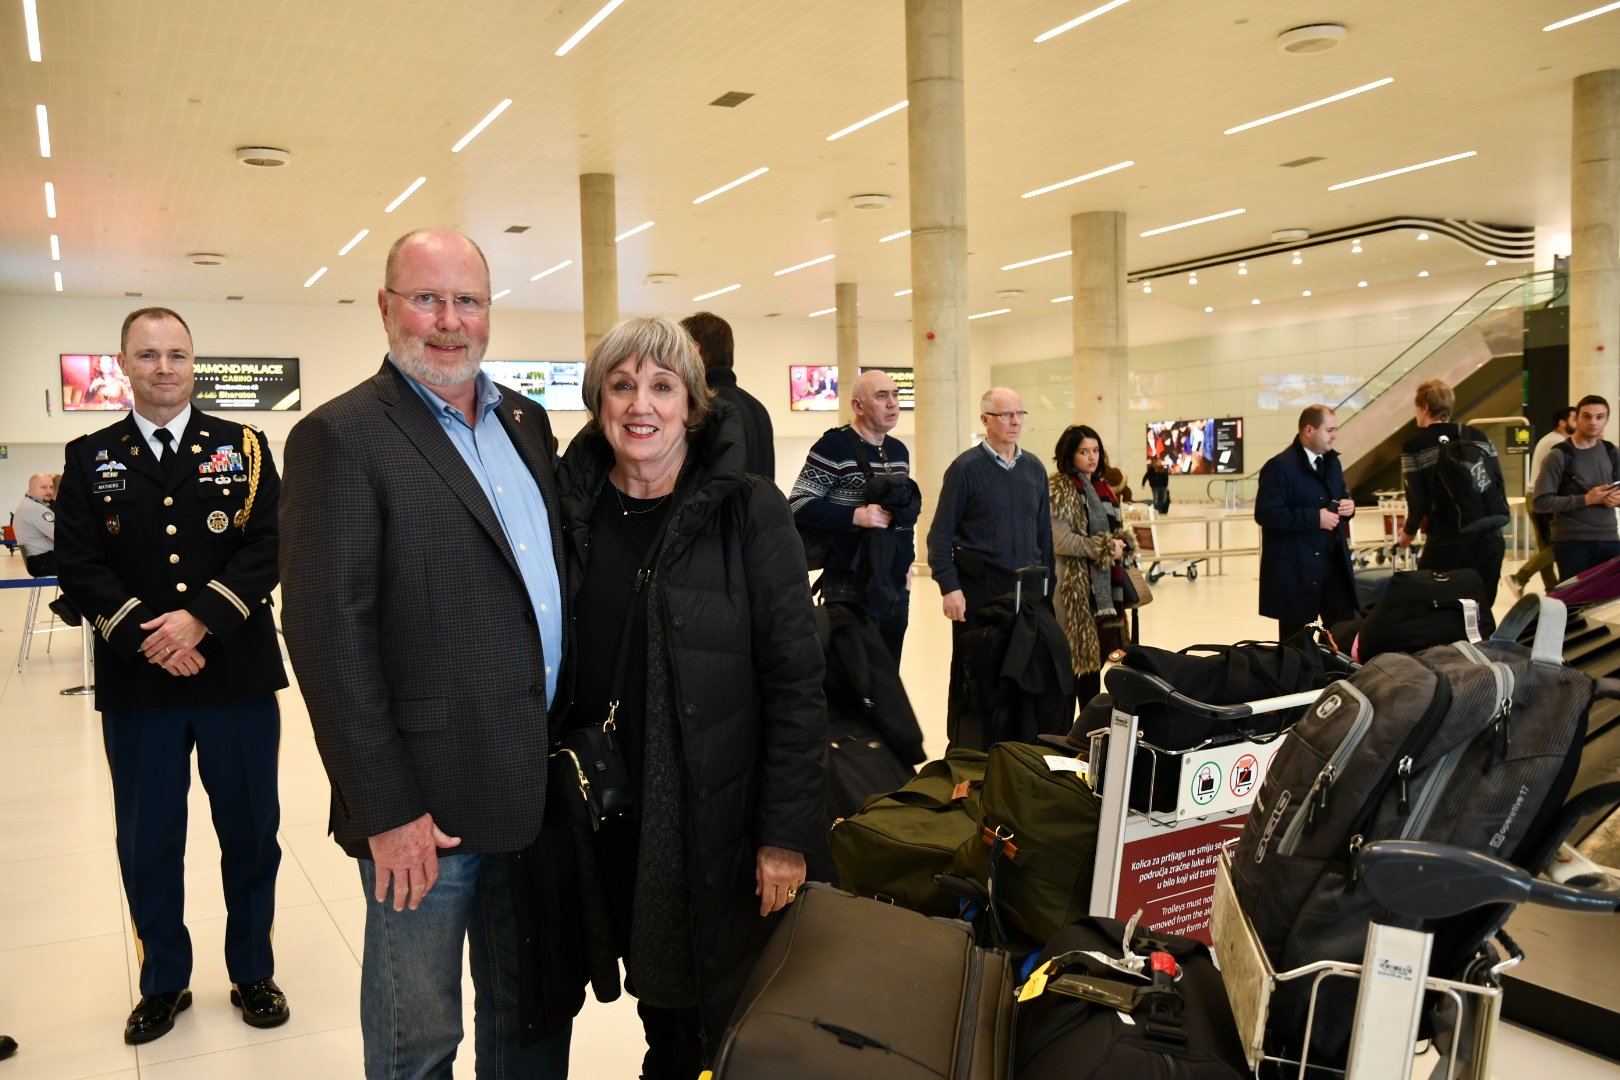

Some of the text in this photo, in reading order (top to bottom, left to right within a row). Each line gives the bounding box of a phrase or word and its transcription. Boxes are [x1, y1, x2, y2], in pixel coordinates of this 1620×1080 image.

[241, 364, 283, 374] PALACE
[1131, 859, 1151, 871] Kolica
[1151, 857, 1160, 866] za
[1160, 850, 1187, 865] prtljagu
[1187, 847, 1196, 857] ne
[1196, 843, 1214, 855] smiju
[1214, 841, 1222, 851] se
[1190, 857, 1205, 868] luke
[1156, 881, 1162, 890] u
[1162, 877, 1176, 889] bilo
[1176, 873, 1189, 885] koji
[1189, 870, 1199, 881] vid
[1162, 903, 1186, 916] Trolleys
[1186, 897, 1202, 909] must
[1176, 913, 1192, 926] from
[1192, 910, 1203, 919] the
[1203, 907, 1213, 916] air
[1186, 922, 1202, 934] form
[1201, 917, 1210, 928] of
